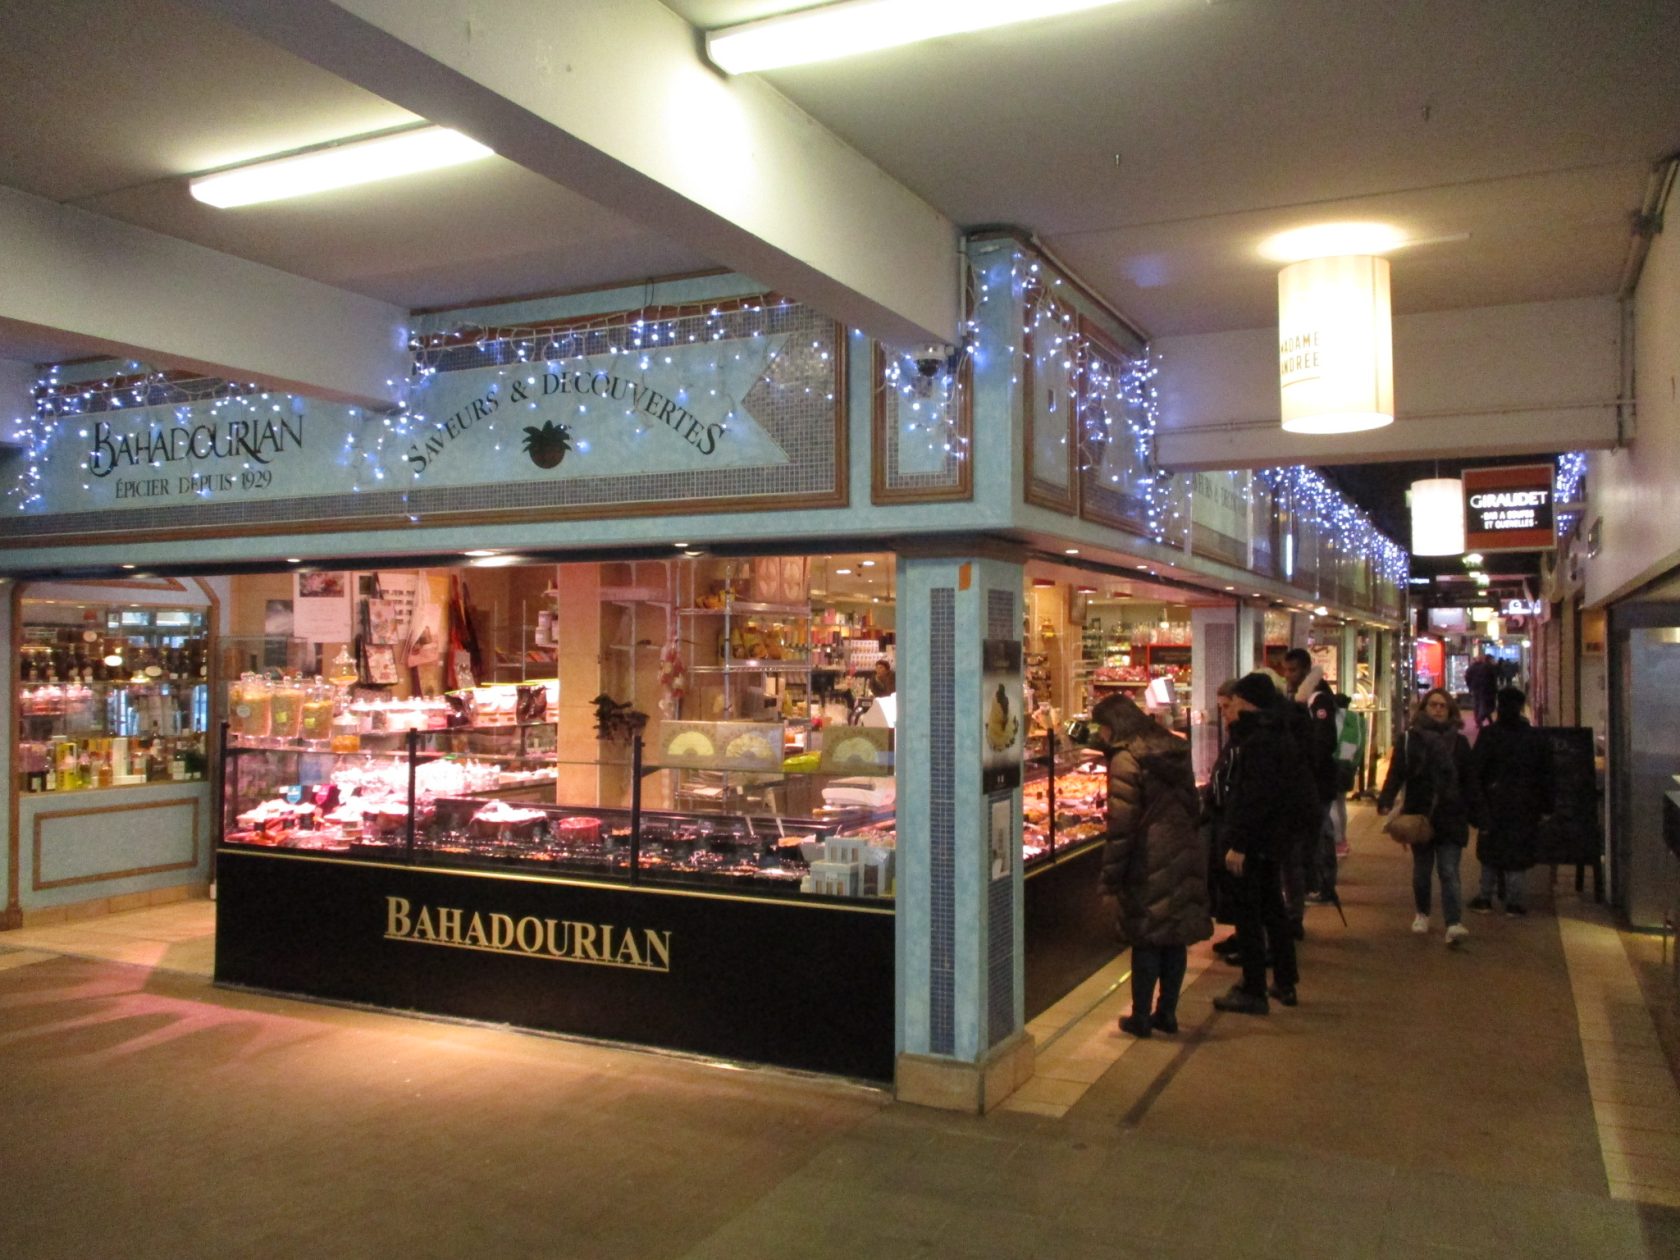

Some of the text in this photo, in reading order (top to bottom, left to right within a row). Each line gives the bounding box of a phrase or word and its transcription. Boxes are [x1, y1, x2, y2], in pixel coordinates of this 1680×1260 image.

[90, 415, 304, 478] BAHADOURIAN
[408, 391, 499, 474] SAVEURS
[511, 380, 528, 403] &
[115, 470, 273, 499] ÉPICIER DEPUIS 1929
[1470, 491, 1548, 508] GIRAUDET
[385, 896, 672, 969] BAHADOURIAN
